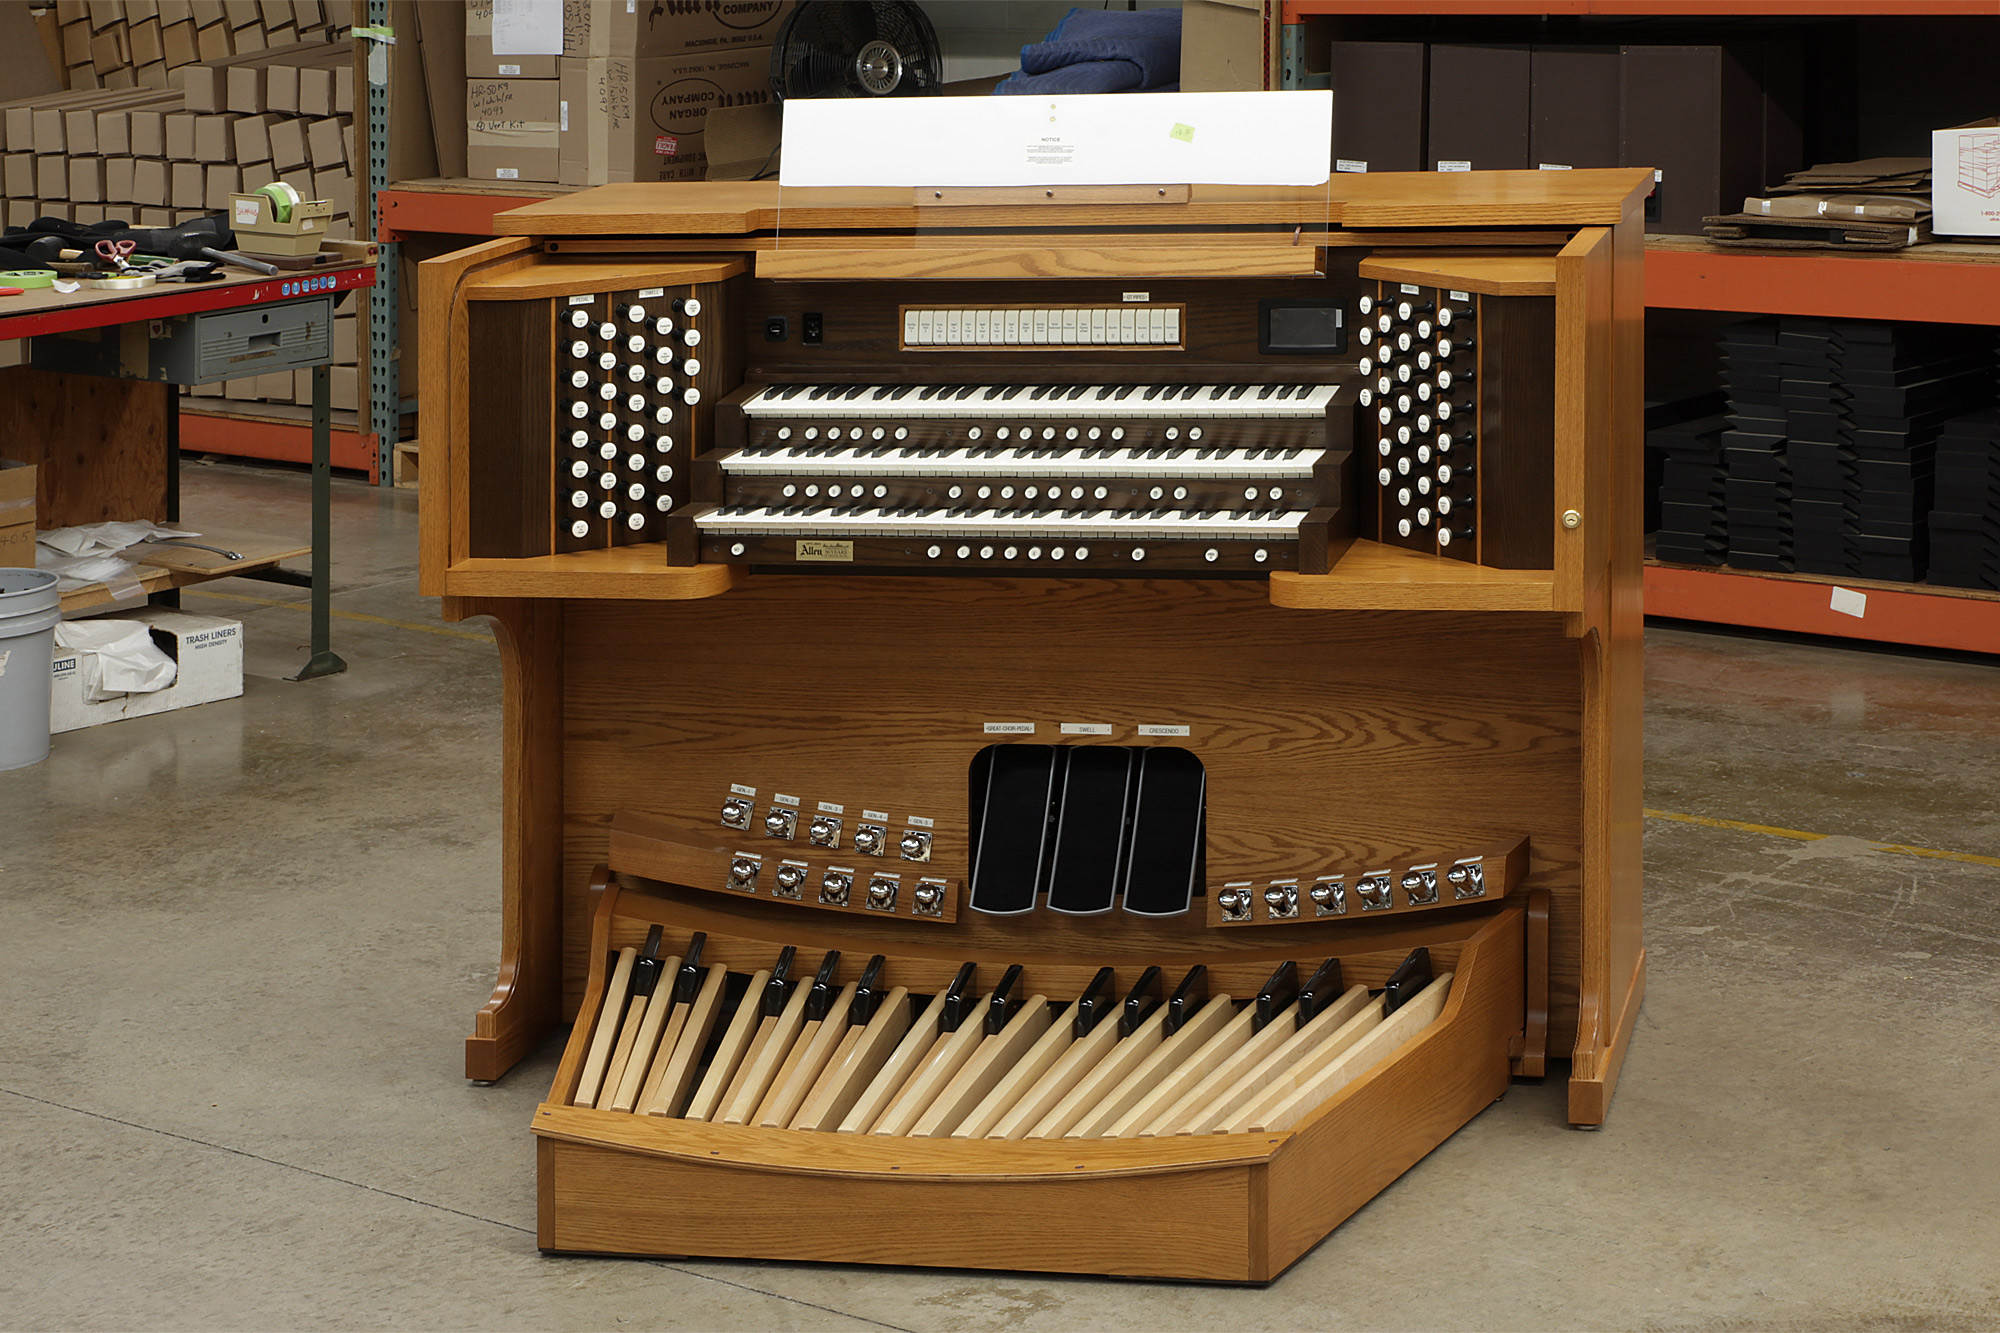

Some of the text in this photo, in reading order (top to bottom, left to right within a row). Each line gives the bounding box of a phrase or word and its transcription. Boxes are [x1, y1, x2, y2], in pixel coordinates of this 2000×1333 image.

[723, 1, 774, 15] COMPANY
[599, 77, 608, 113] 4097
[661, 91, 715, 106] COMPANY
[481, 106, 504, 116] 4093
[669, 107, 707, 120] ORGAN
[659, 170, 675, 180] CARE
[800, 543, 823, 556] Allen
[186, 628, 236, 645] TRASH LINERS
[208, 639, 227, 648] DENSITY
